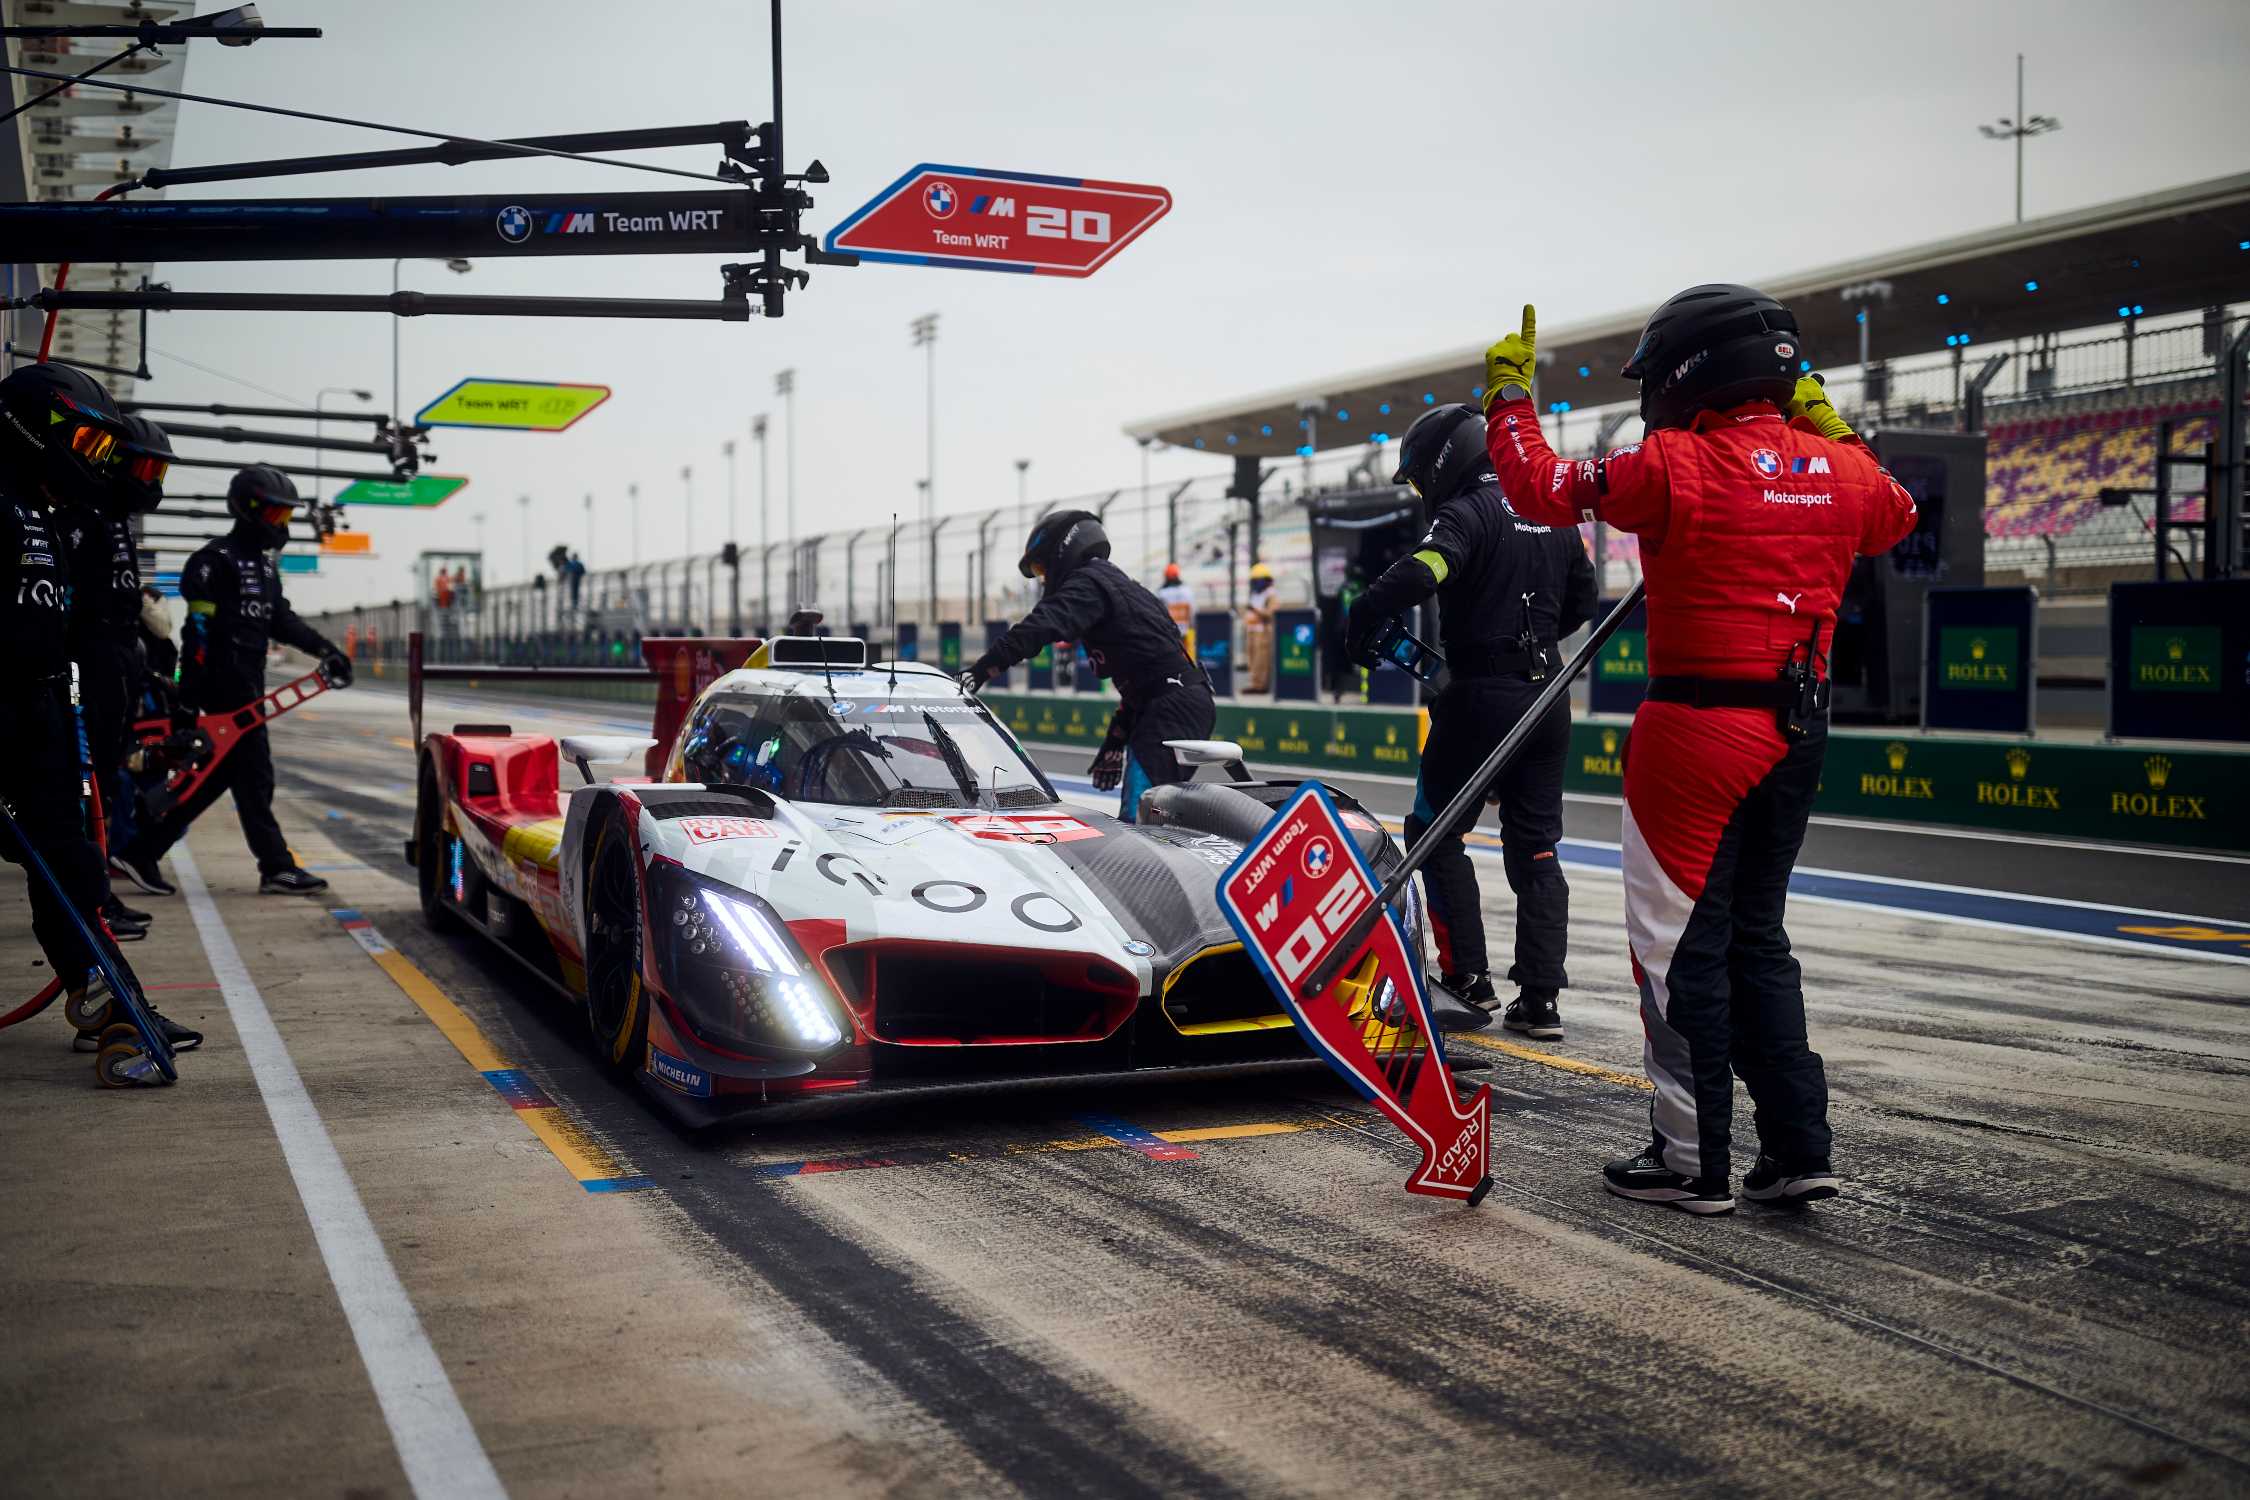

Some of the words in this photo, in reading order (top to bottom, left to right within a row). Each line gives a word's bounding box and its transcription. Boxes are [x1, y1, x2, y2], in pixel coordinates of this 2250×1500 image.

[603, 212, 663, 232] Team
[669, 210, 723, 231] WRT
[1027, 205, 1111, 243] 20
[933, 229, 972, 247] Team
[974, 233, 1009, 250] WRT
[1763, 489, 1832, 507] Motorsport
[1947, 663, 2009, 681] ROLEX
[2140, 664, 2211, 683] ROLEX
[1860, 773, 1934, 799] ROLEX
[1977, 782, 2061, 810] ROLEX
[2111, 793, 2207, 820] ROLEX
[693, 825, 769, 839] CAR
[1272, 818, 1308, 856] Team
[771, 840, 1083, 933] iQOO
[1244, 854, 1277, 895] WRT
[1275, 867, 1366, 983] 20
[658, 1061, 700, 1087] MICHELIN
[1436, 1118, 1479, 1180] READY
[1452, 1143, 1478, 1182] GET
